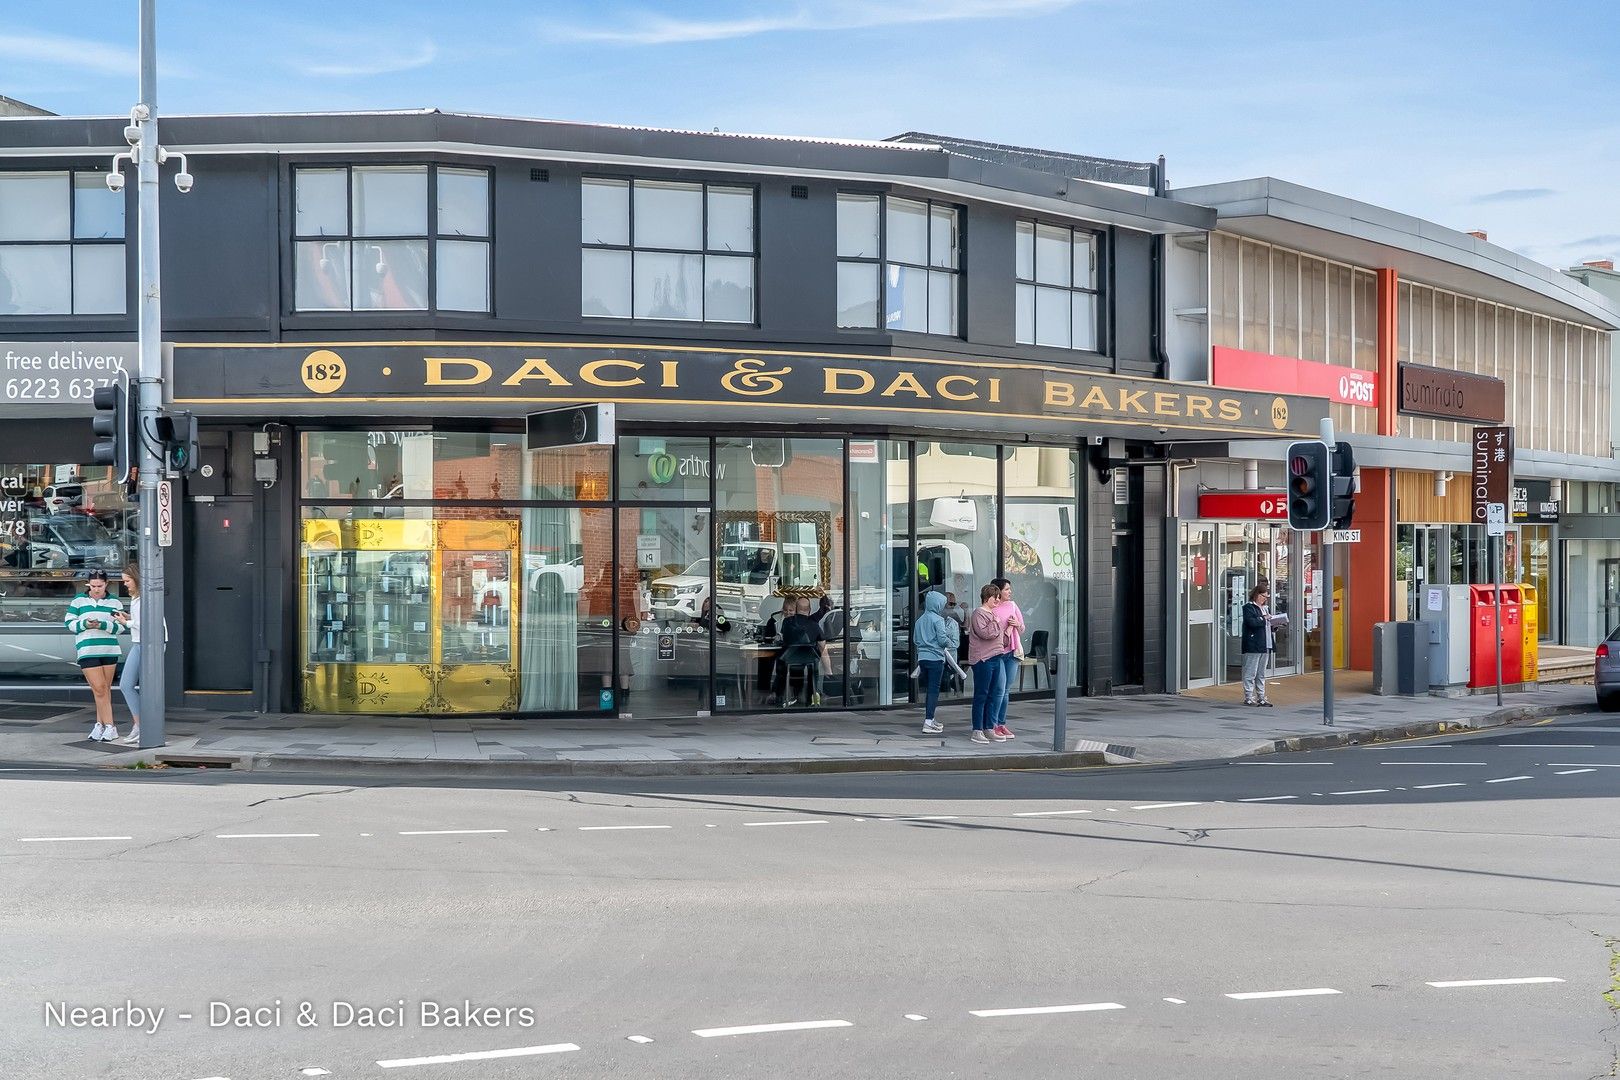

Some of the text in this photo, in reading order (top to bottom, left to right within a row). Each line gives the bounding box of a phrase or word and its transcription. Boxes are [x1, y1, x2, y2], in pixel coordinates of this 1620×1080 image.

[5, 351, 124, 374] free delivery
[6, 378, 60, 399] 6223
[306, 358, 1286, 421] 182 DACI & DACI BAKERS 182
[1350, 379, 1374, 402] POST
[1405, 379, 1464, 409] suminato
[1, 472, 25, 489] cal
[1475, 432, 1491, 518] suminato
[1333, 531, 1359, 541] KING ST
